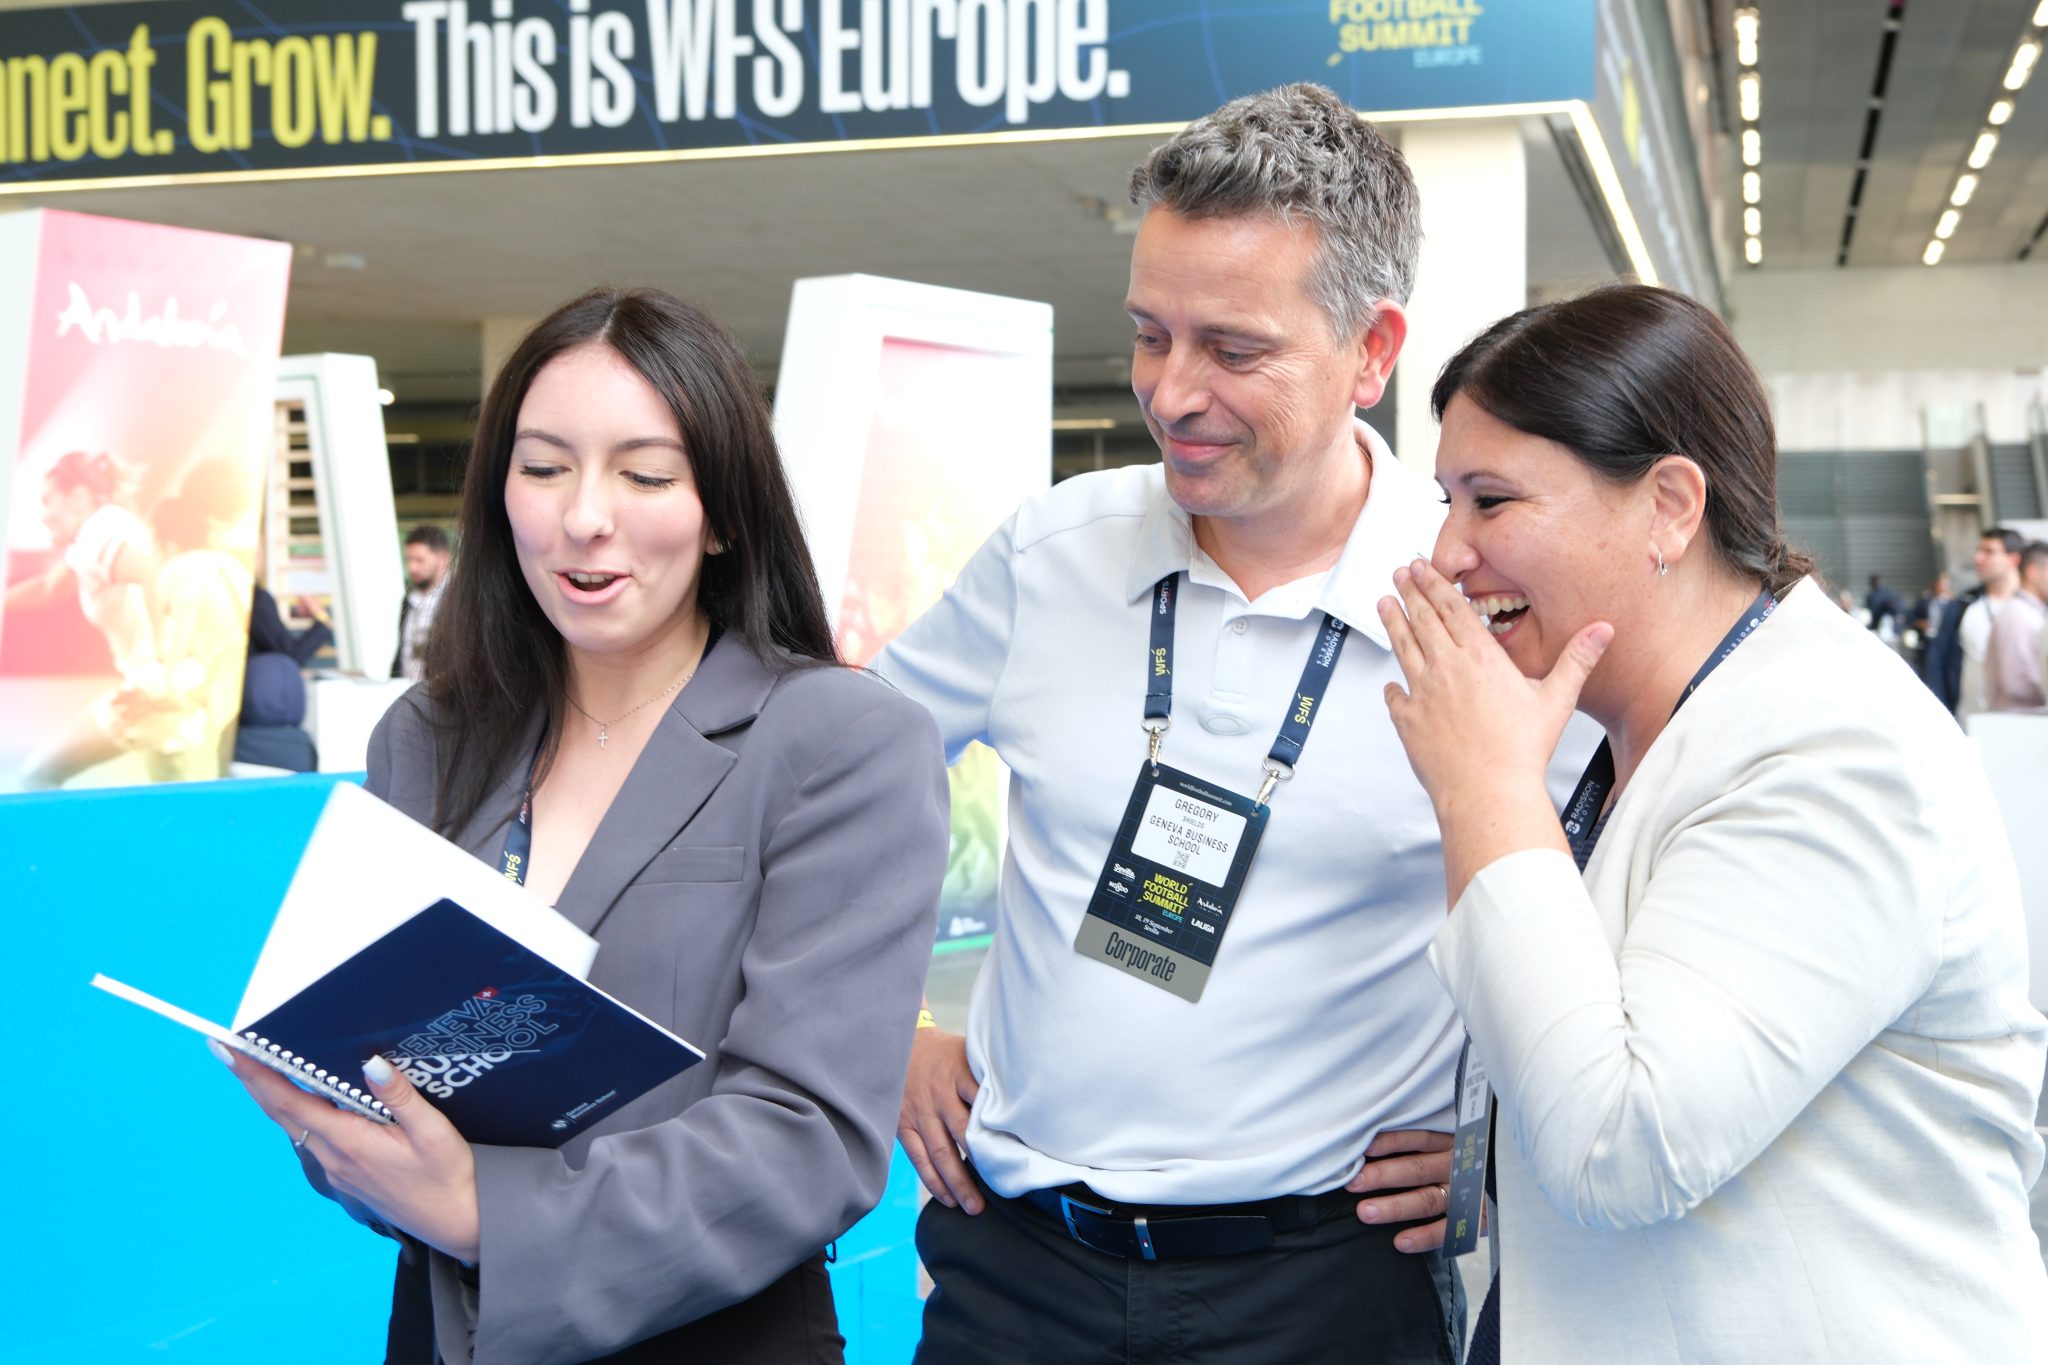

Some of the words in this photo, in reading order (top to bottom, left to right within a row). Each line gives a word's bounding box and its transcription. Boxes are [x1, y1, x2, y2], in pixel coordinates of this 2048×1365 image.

[1339, 17, 1474, 52] SUMMIT
[402, 0, 557, 138] This
[569, 0, 636, 129] is
[645, 0, 804, 123] WFS
[818, 0, 1130, 124] Europe.
[0, 22, 175, 163] nect.
[186, 17, 392, 153] Grow.
[1155, 647, 1166, 677] WFS
[1316, 629, 1332, 666] HOTELS
[1322, 631, 1341, 668] RADISSON
[1294, 695, 1314, 724] WFS
[1174, 798, 1219, 823] GREGORY
[1571, 780, 1595, 820] RADISSON
[1149, 814, 1183, 836] GENEVA
[1185, 828, 1229, 854] BUSINESS
[1182, 815, 1205, 829] SHIELDS
[1167, 834, 1201, 856] SCHOOL
[504, 853, 522, 882] WFS
[1142, 879, 1189, 908] FOOTBALL
[1154, 872, 1188, 895] WORLD
[1142, 890, 1185, 915] SUMMIT
[1162, 908, 1184, 924] EUROPE
[1190, 917, 1215, 935] LALIGA
[1104, 931, 1177, 982] Corporate
[403, 994, 547, 1088] BUSINESS
[426, 1019, 560, 1099] SCHOOL
